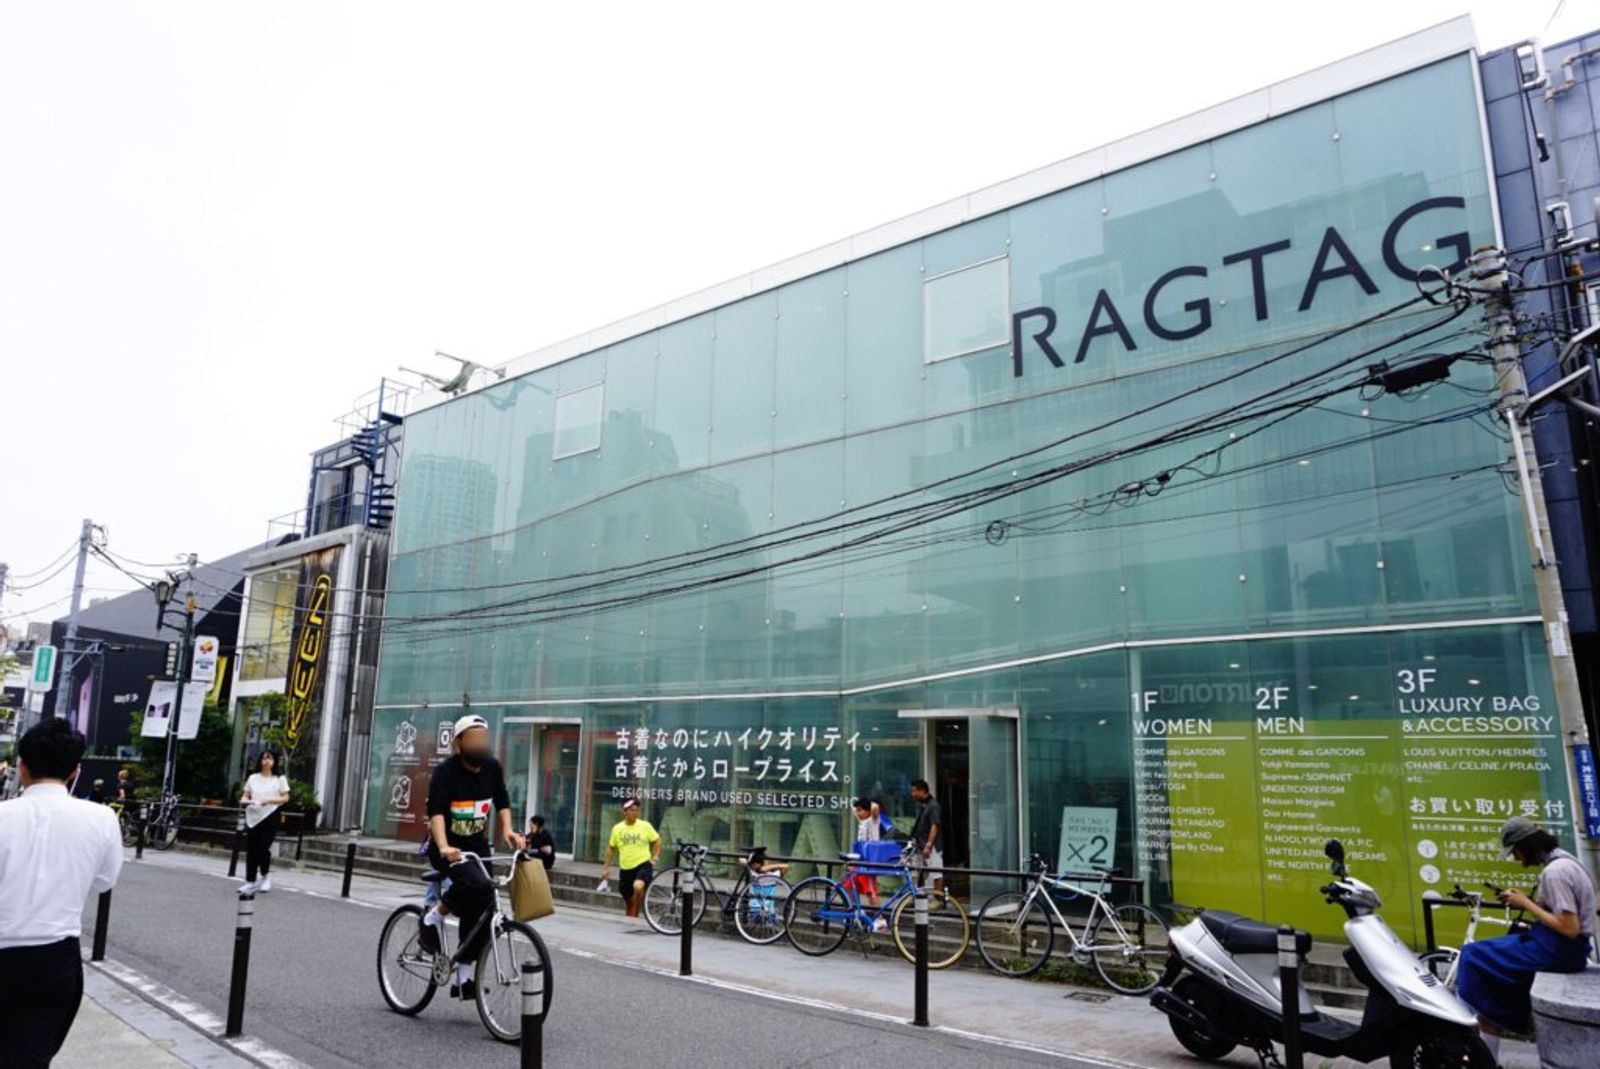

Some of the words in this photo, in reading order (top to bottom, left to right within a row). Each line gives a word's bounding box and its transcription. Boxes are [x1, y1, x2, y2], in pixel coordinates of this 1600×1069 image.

[1012, 196, 1473, 377] RAGTAG
[1397, 668, 1437, 694] 3F
[1131, 691, 1158, 712] 1F
[1255, 687, 1290, 710] 2F
[1399, 697, 1484, 713] LUXURY
[1492, 696, 1541, 712] BAG
[1132, 718, 1212, 735] WOMEN
[1257, 717, 1305, 733] MEN
[1401, 716, 1553, 733] &ACCESSORY
[615, 727, 872, 752] 古着なのにハイクオリティ。
[1404, 747, 1436, 757] LOUIS
[614, 755, 851, 784] 古着だからロープライス。
[677, 788, 717, 802] BRAND
[720, 791, 752, 804] USED
[757, 793, 825, 808] SELECTED
[1409, 796, 1565, 818] お買い取り受付
[1268, 860, 1286, 869] THE
[1288, 861, 1323, 870] NORTH
